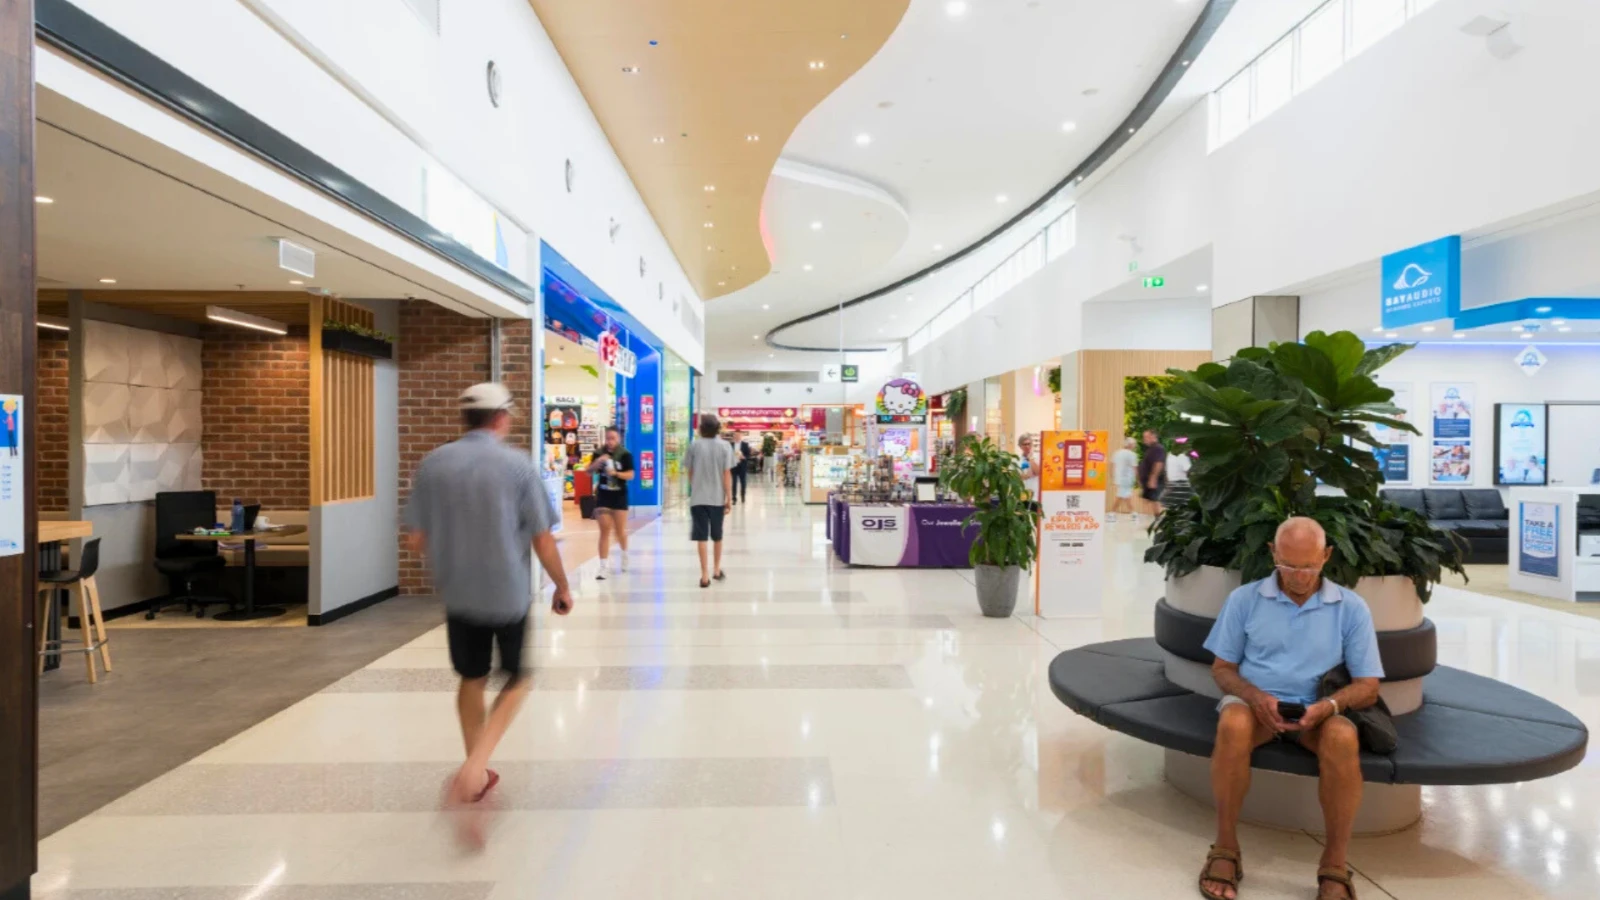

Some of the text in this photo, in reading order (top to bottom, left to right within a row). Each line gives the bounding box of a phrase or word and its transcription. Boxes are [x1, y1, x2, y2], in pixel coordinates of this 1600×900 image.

[1525, 519, 1554, 529] TAKE A
[1525, 526, 1553, 537] FREE
